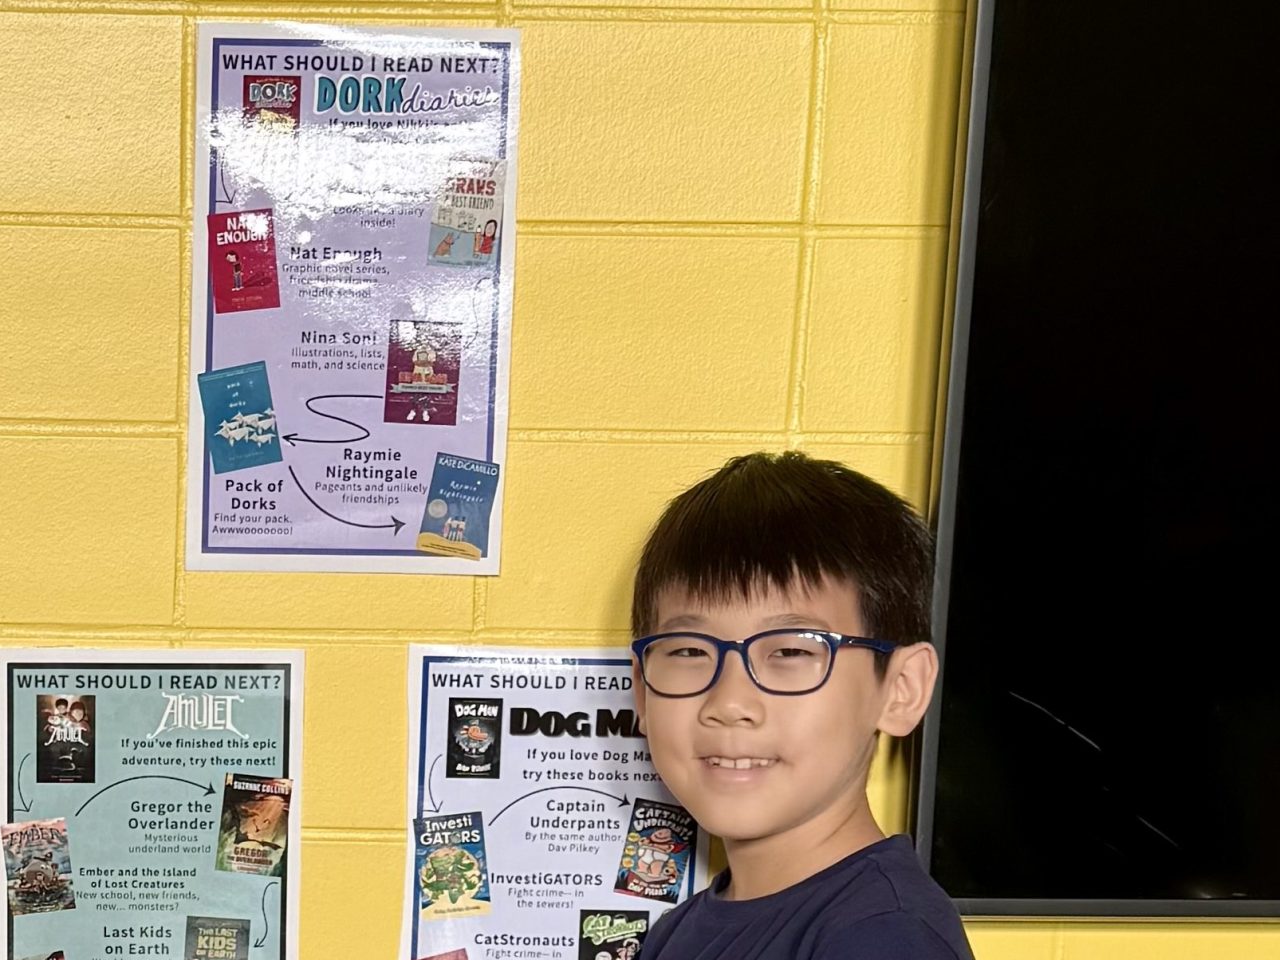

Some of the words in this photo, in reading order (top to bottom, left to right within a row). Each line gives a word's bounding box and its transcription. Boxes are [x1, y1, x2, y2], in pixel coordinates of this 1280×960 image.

[223, 55, 277, 71] WHAT
[284, 56, 363, 72] SHOULD
[371, 57, 375, 72] I
[385, 57, 432, 73] READ
[440, 58, 499, 74] NEXT?
[250, 82, 297, 101] DORK
[317, 76, 406, 114] DORK
[302, 331, 336, 344] Nina
[291, 360, 320, 370] math,
[324, 360, 342, 369] and
[347, 361, 384, 370] science
[344, 449, 401, 463] Raymie
[326, 465, 417, 481] Nightingale
[226, 480, 261, 492] Pack
[267, 480, 283, 491] of
[231, 497, 276, 510] Dorks
[342, 494, 399, 505] friendships
[214, 513, 235, 523] Find
[239, 515, 261, 526] your
[265, 515, 292, 526] pack.
[17, 675, 68, 688] WHAT
[76, 675, 151, 690] SHOULD
[159, 676, 162, 689] I
[171, 676, 217, 689] READ
[225, 676, 280, 690] NEXT?
[432, 674, 483, 688] WHAT
[490, 675, 566, 689] SHOULD
[574, 676, 577, 689] I
[585, 677, 632, 690] READ
[510, 707, 591, 738] DOG
[122, 739, 129, 748] If
[134, 739, 171, 750] you've
[176, 739, 223, 749] finished
[227, 739, 249, 748] this
[253, 740, 276, 750] epic
[122, 756, 186, 767] adventure,
[190, 757, 206, 767] try
[211, 757, 242, 766] these
[246, 757, 275, 766] next!
[528, 750, 538, 760] If
[541, 752, 565, 762] you
[570, 750, 598, 761] love
[603, 751, 628, 762] Dog
[523, 771, 542, 782] try
[547, 770, 583, 780] these
[589, 770, 628, 781] books
[131, 801, 183, 815] Gregor
[188, 801, 212, 813] the
[547, 800, 604, 812] Captain
[128, 818, 215, 830] Overlander
[426, 815, 472, 831] Investi
[530, 816, 620, 830] Underpants
[80, 868, 114, 876] Ember
[118, 868, 137, 876] and
[142, 868, 159, 876] the
[163, 868, 196, 876] Island
[91, 880, 101, 888] of
[105, 880, 127, 888] Lost
[132, 880, 184, 889] Creatures
[491, 873, 602, 885] InvestiGATORS
[104, 927, 134, 938] Last
[140, 927, 172, 938] Kids
[198, 936, 236, 950] KIDS
[475, 934, 574, 946] CatStronauts
[105, 945, 123, 955] on
[129, 943, 169, 955] Earth
